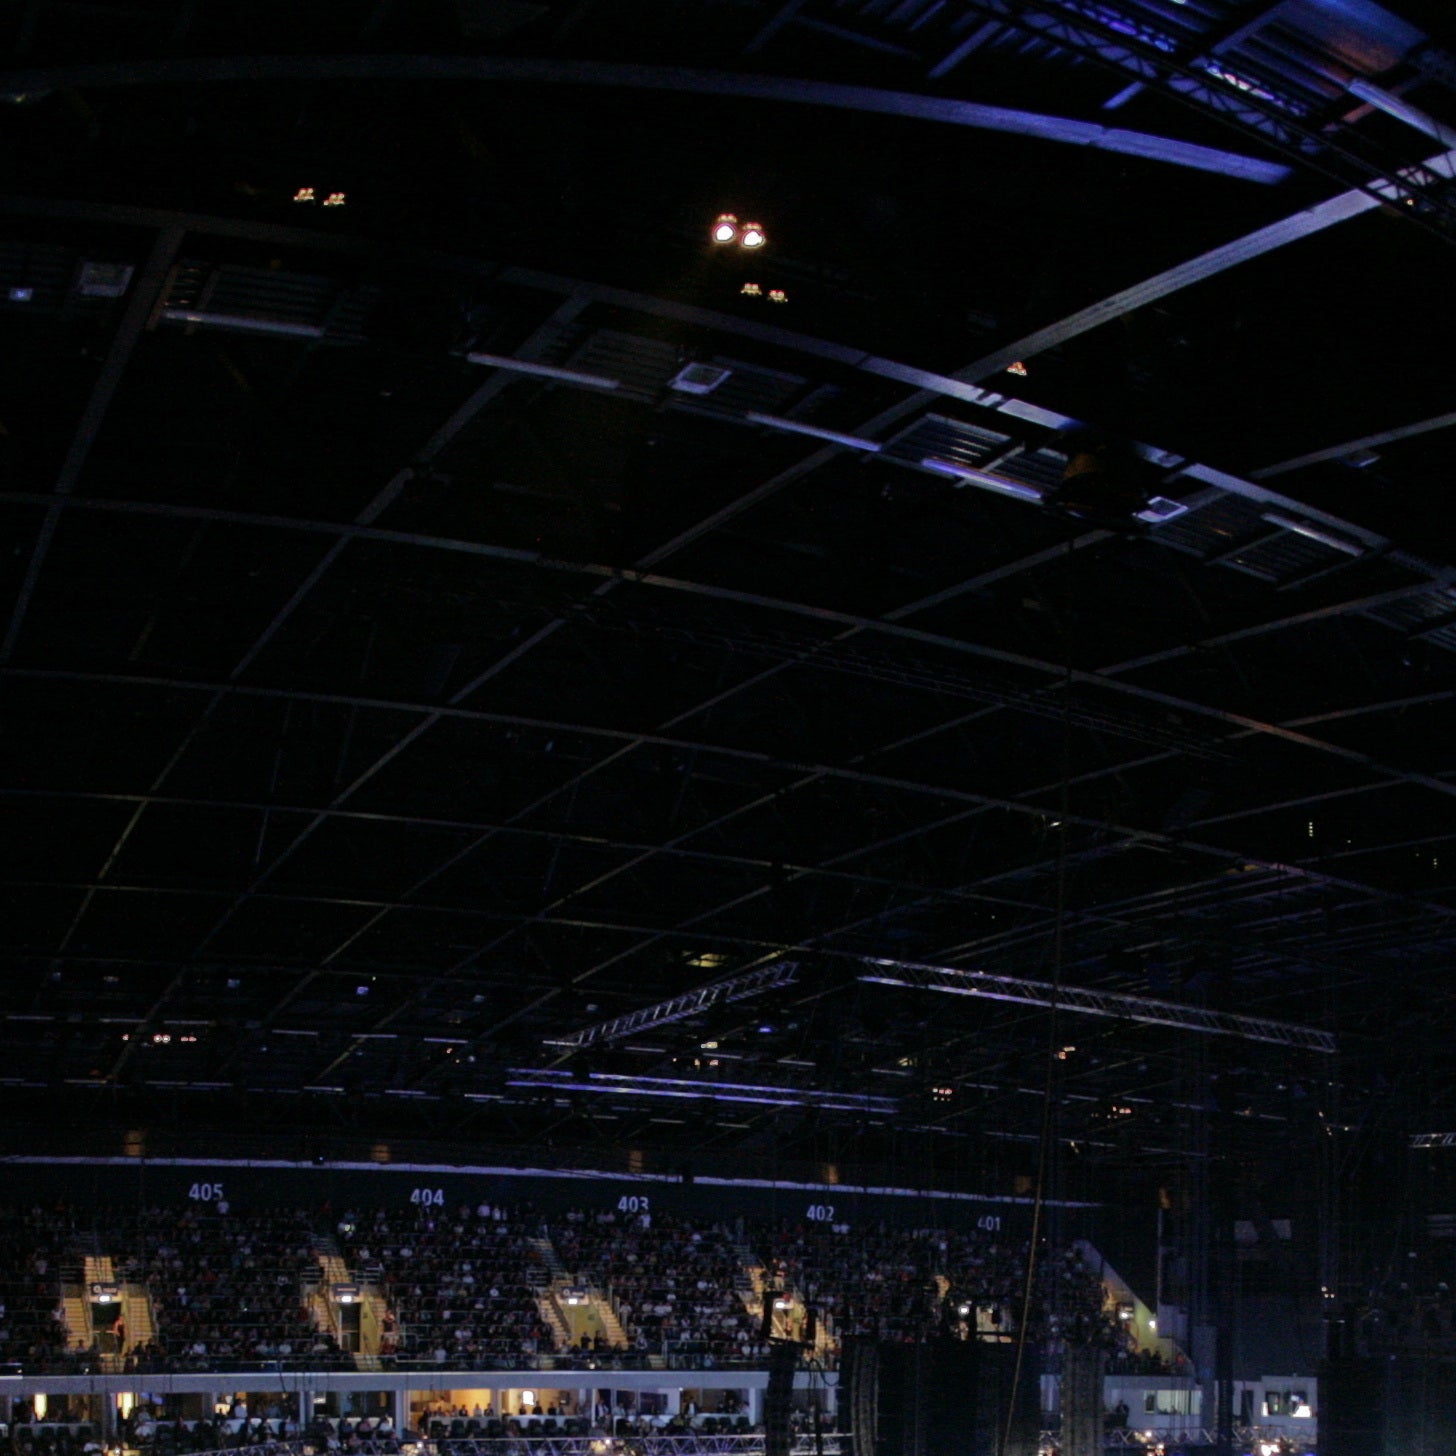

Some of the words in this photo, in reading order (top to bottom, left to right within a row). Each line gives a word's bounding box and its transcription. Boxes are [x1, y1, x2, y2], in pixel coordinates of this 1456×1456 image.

[188, 1182, 224, 1201] 405
[410, 1188, 444, 1207] 404
[618, 1195, 650, 1214] 403
[807, 1204, 835, 1222] 402
